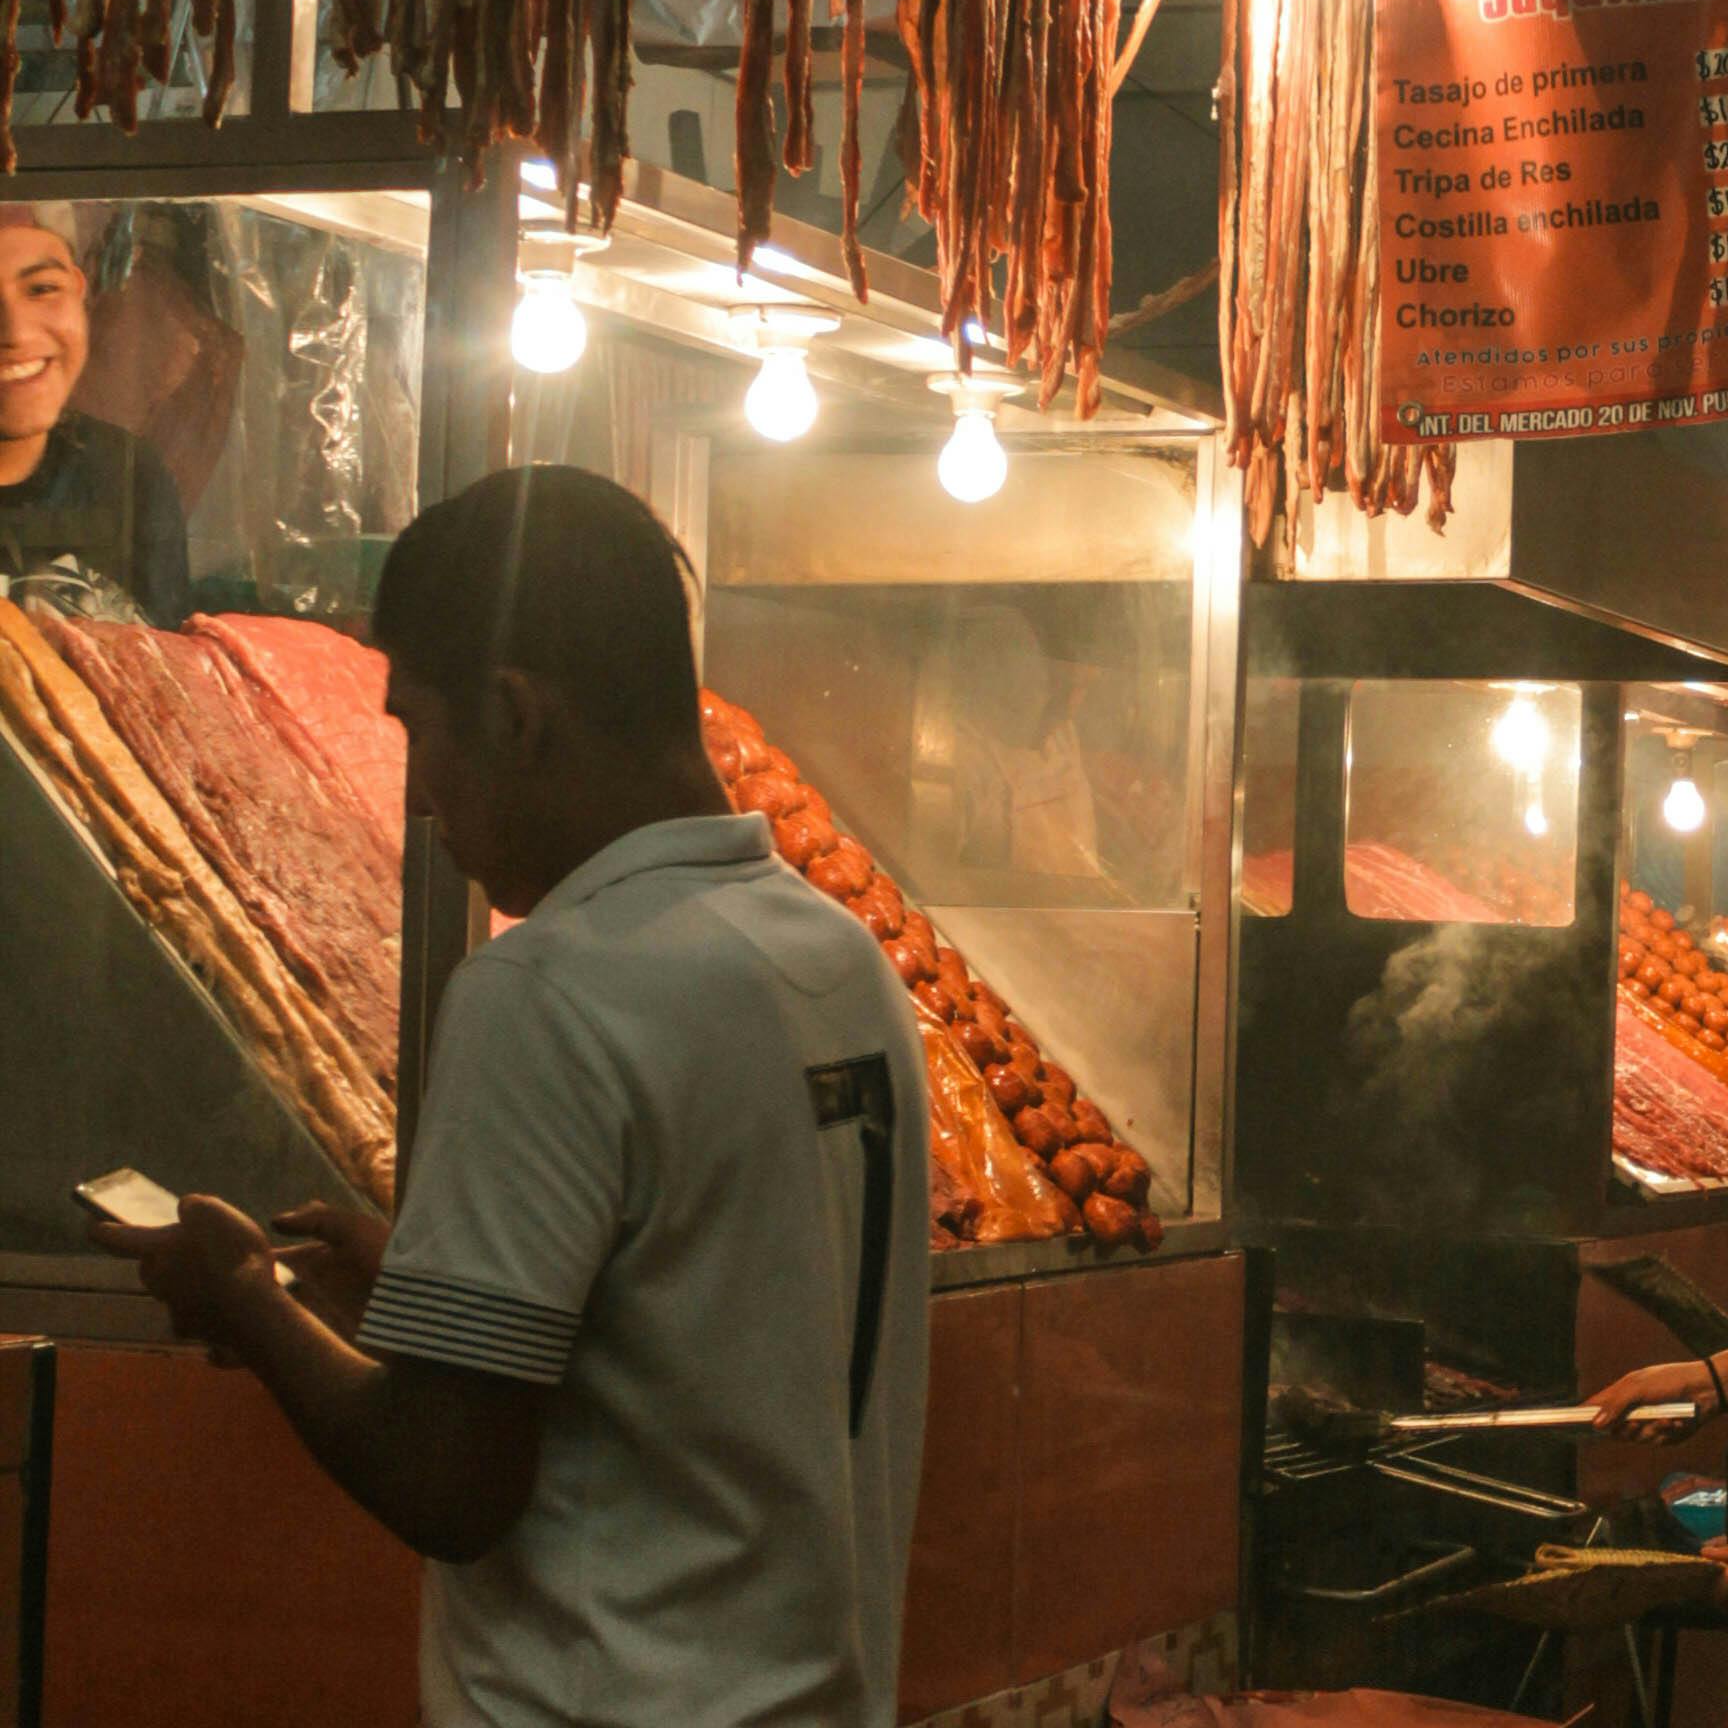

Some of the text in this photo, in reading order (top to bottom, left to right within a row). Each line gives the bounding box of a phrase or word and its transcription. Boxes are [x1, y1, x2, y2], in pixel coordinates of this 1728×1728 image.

[1392, 77, 1488, 107] Tasajo
[1494, 71, 1523, 97] de
[1531, 59, 1649, 98] primera
[1393, 122, 1495, 149] Cecina
[1503, 104, 1646, 142] Enchilada
[1393, 168, 1471, 198] Tripa
[1479, 165, 1512, 191] de
[1520, 160, 1573, 186] Res
[1393, 212, 1509, 239] Costilla
[1516, 195, 1661, 234] enchilada
[1395, 257, 1471, 284] Ubre
[1395, 302, 1516, 330] Chorizo
[1415, 343, 1549, 368] Atendidos
[1556, 341, 1601, 364] por
[1608, 335, 1649, 357] sus
[1440, 373, 1576, 393] Estamos
[1459, 413, 1494, 433] DEL
[1500, 407, 1593, 432] MERCADO
[1597, 405, 1624, 426] 20
[1627, 401, 1654, 422] DE
[1657, 396, 1699, 420] NOV.
